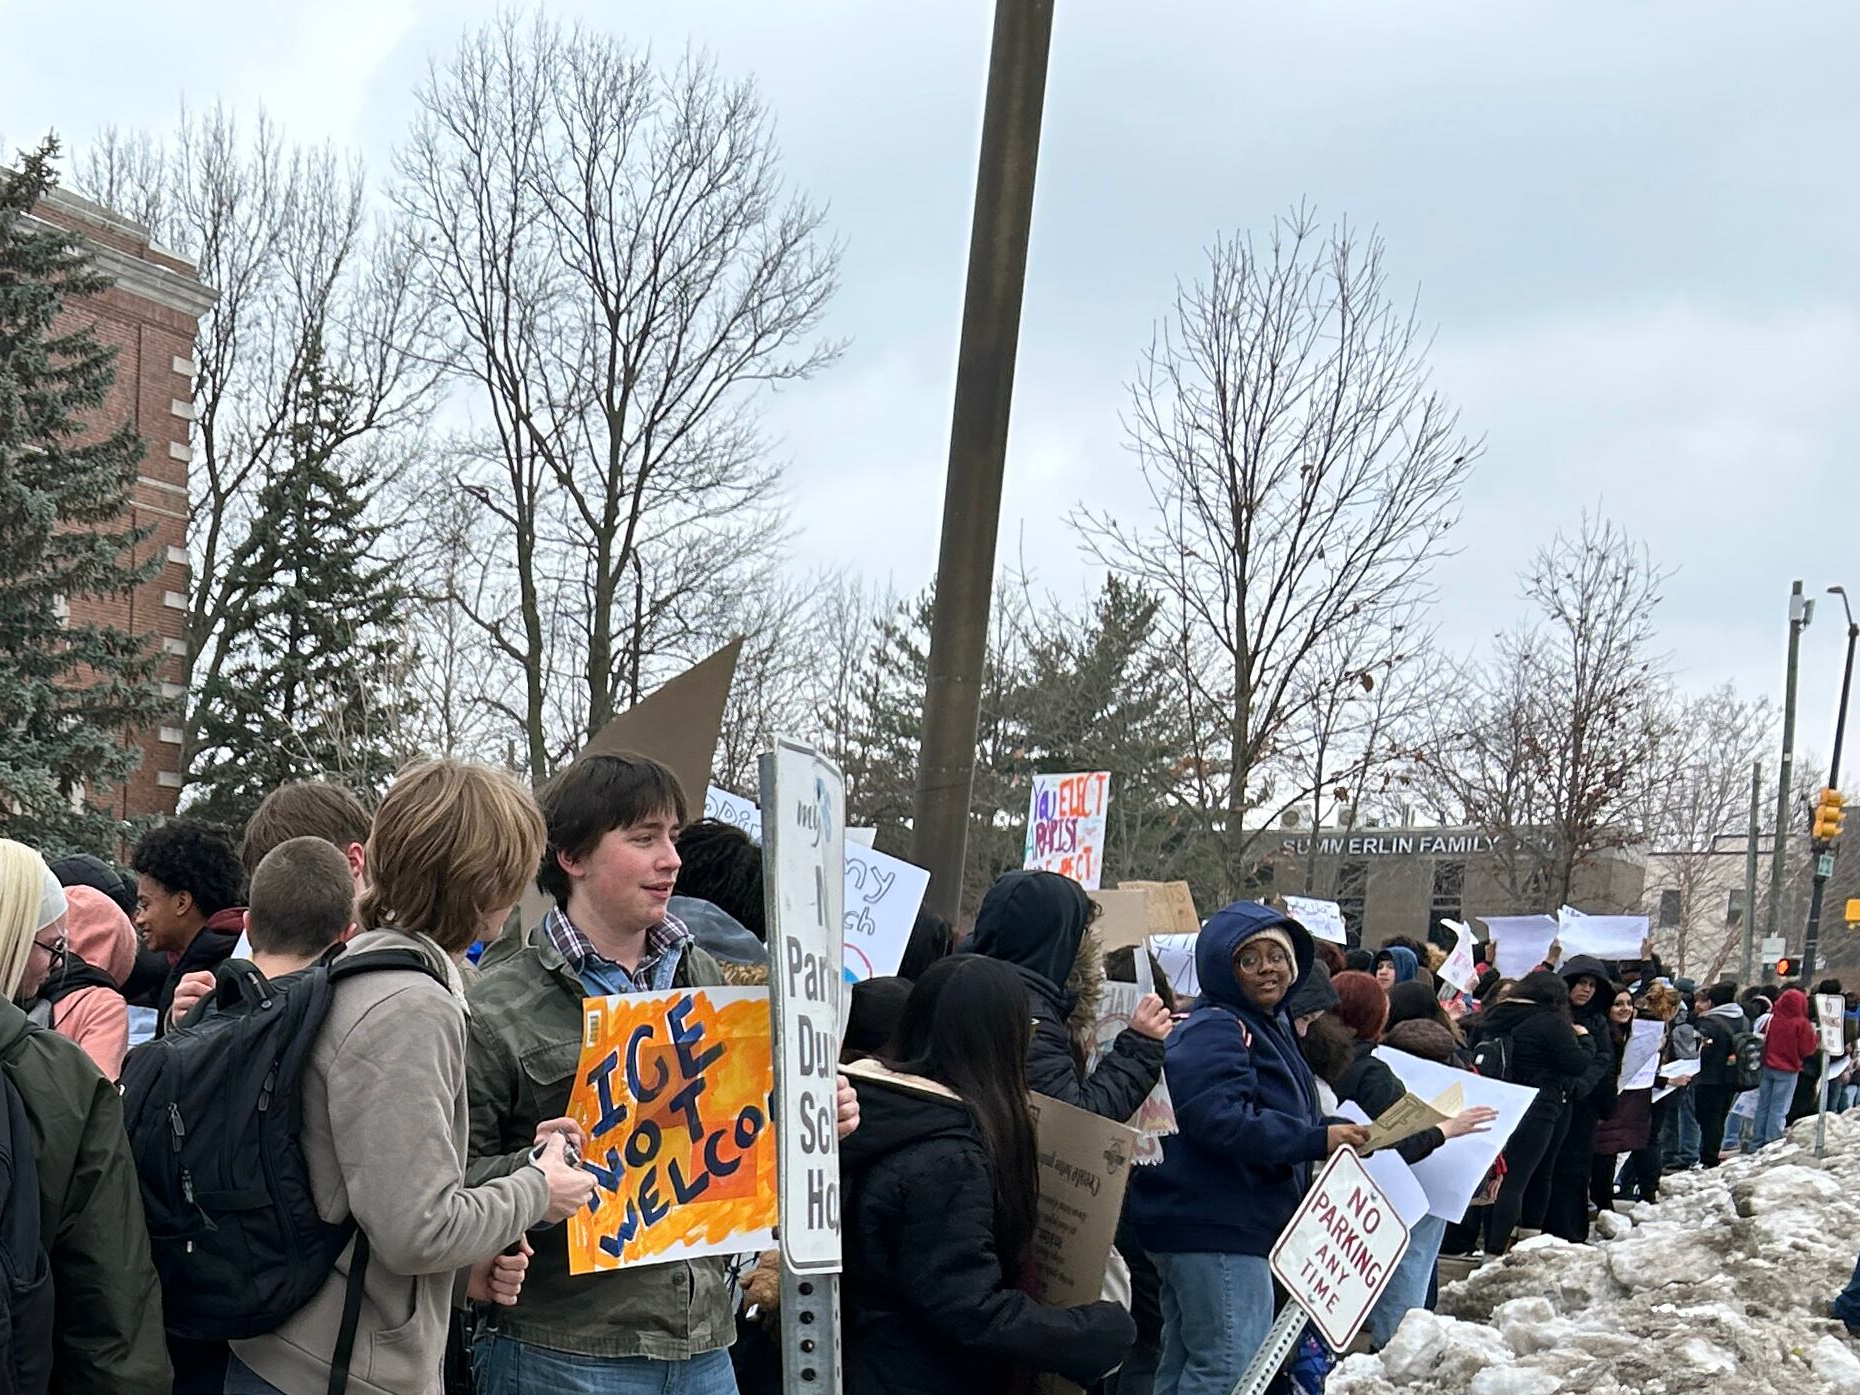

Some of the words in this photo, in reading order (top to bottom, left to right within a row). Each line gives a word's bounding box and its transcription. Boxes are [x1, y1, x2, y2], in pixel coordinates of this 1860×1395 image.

[1059, 772, 1106, 817] ELECT
[1419, 835, 1501, 852] FAMILY
[586, 995, 727, 1138] ICE
[581, 1077, 707, 1215] NOT
[599, 1090, 775, 1258] WELCO
[1347, 1185, 1381, 1235] NO
[1311, 1190, 1382, 1289] PARKING
[1315, 1243, 1350, 1286] ANY
[1300, 1258, 1340, 1315] TIME
